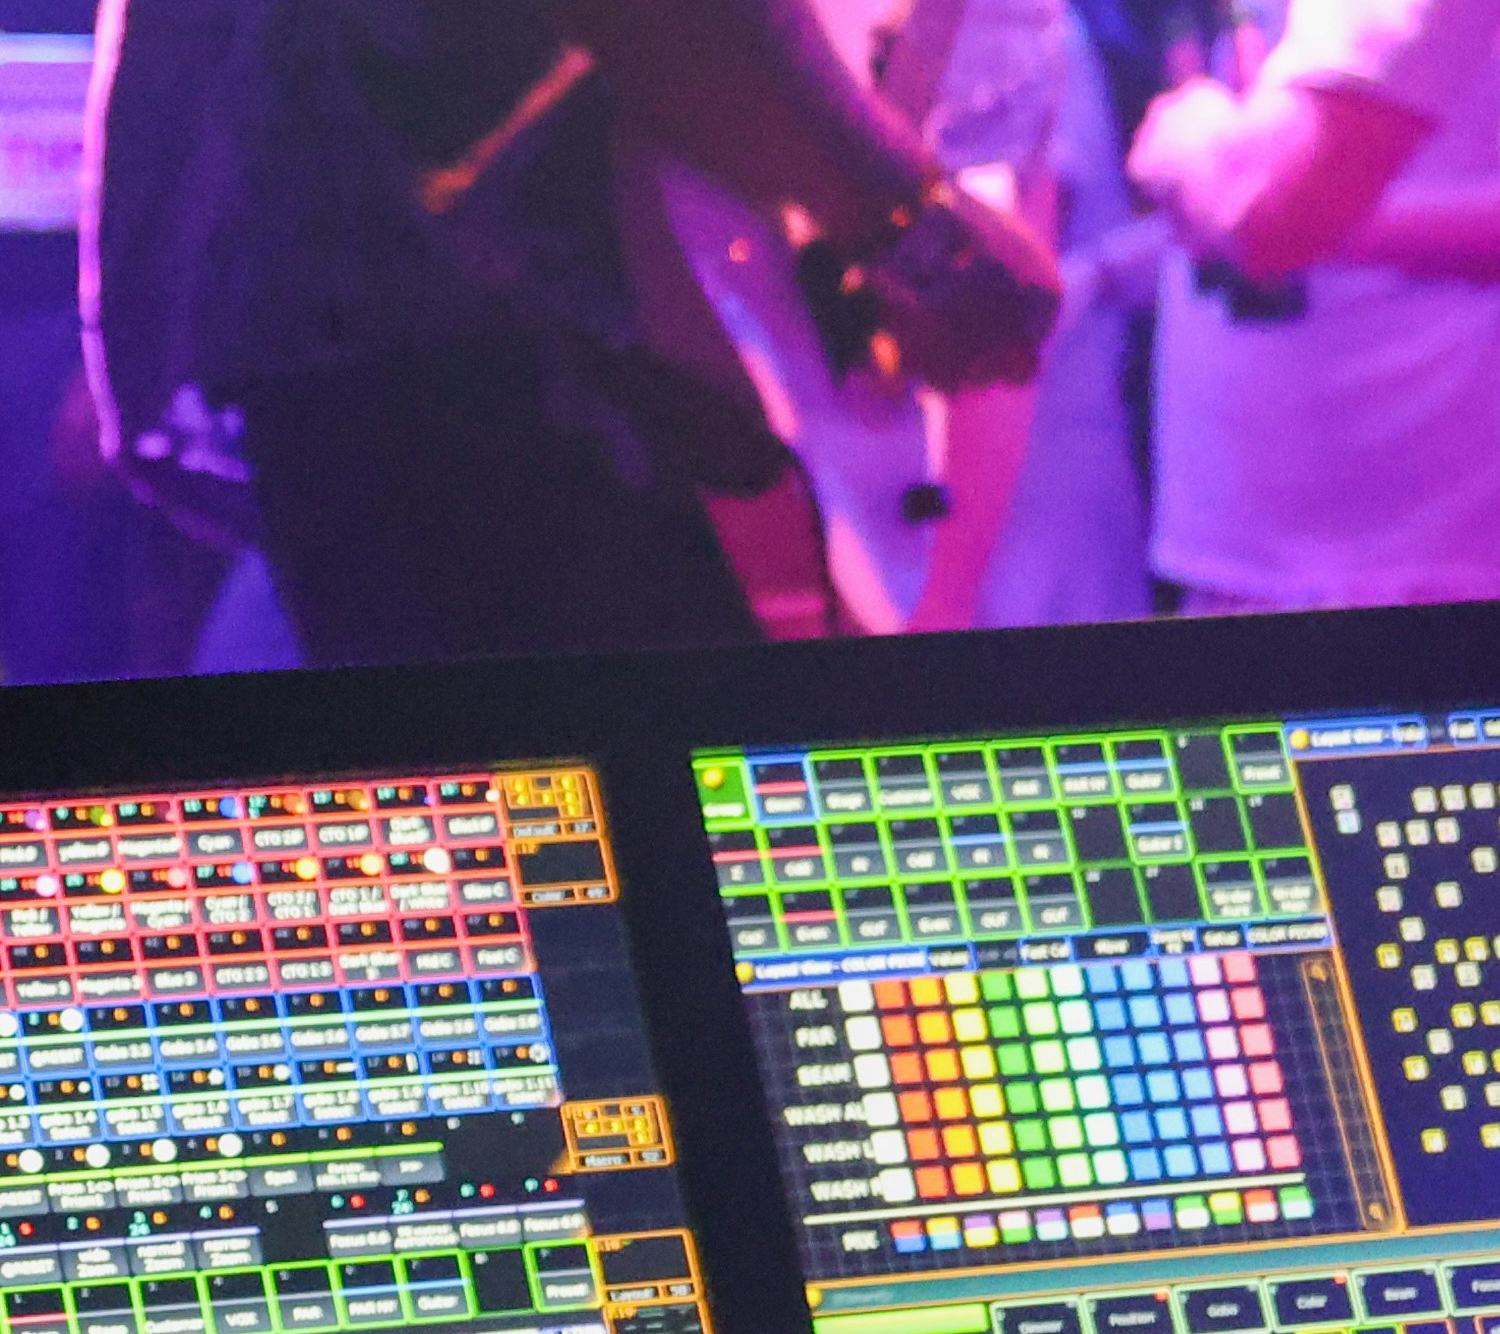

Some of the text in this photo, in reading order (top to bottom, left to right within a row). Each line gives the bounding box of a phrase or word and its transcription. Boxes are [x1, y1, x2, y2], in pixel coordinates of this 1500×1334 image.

[789, 989, 827, 1010] ALL
[795, 1027, 837, 1047] PAR
[797, 1063, 850, 1086] BEAM
